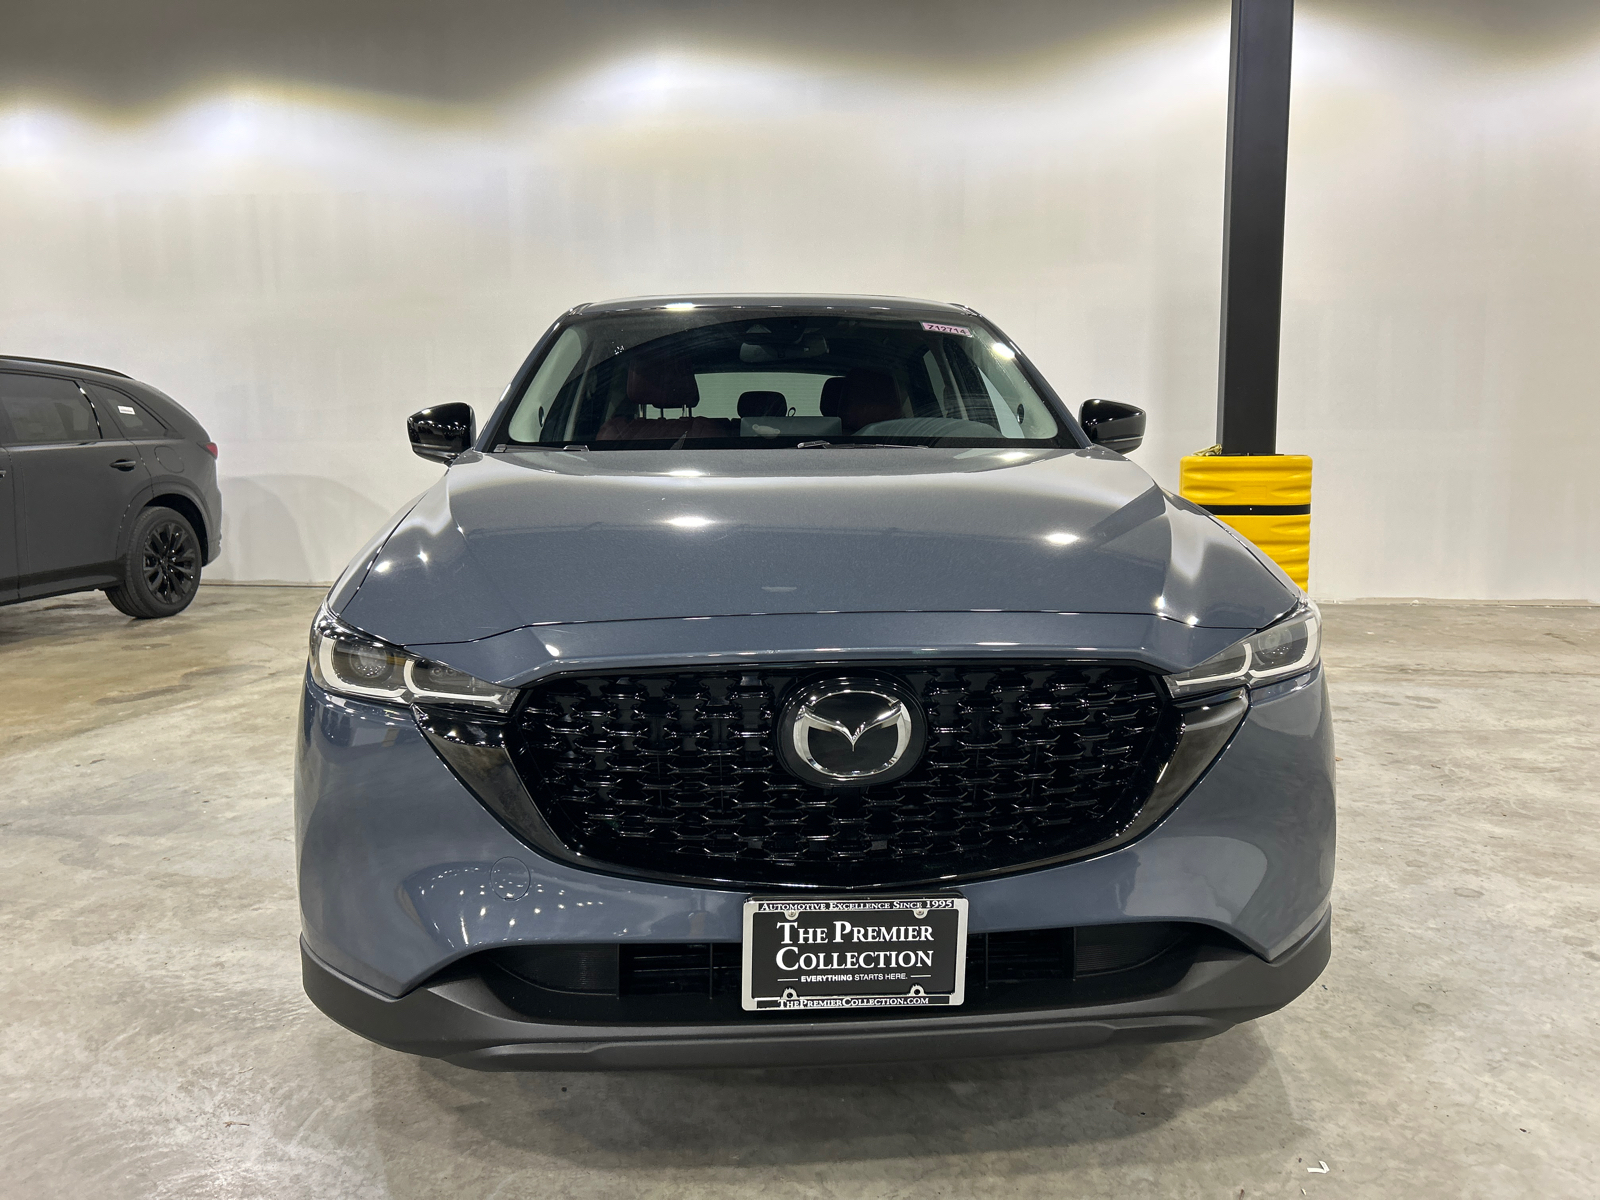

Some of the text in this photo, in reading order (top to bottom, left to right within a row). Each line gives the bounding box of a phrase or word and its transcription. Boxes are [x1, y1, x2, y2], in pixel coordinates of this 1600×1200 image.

[761, 900, 953, 911] AUTOMOTIVE EXCELLENCE SINCE 1995
[777, 920, 934, 944] THE PREMIER
[775, 946, 934, 971] COLLECTION
[800, 974, 853, 982] EVERYTHING
[854, 973, 884, 981] STARTS
